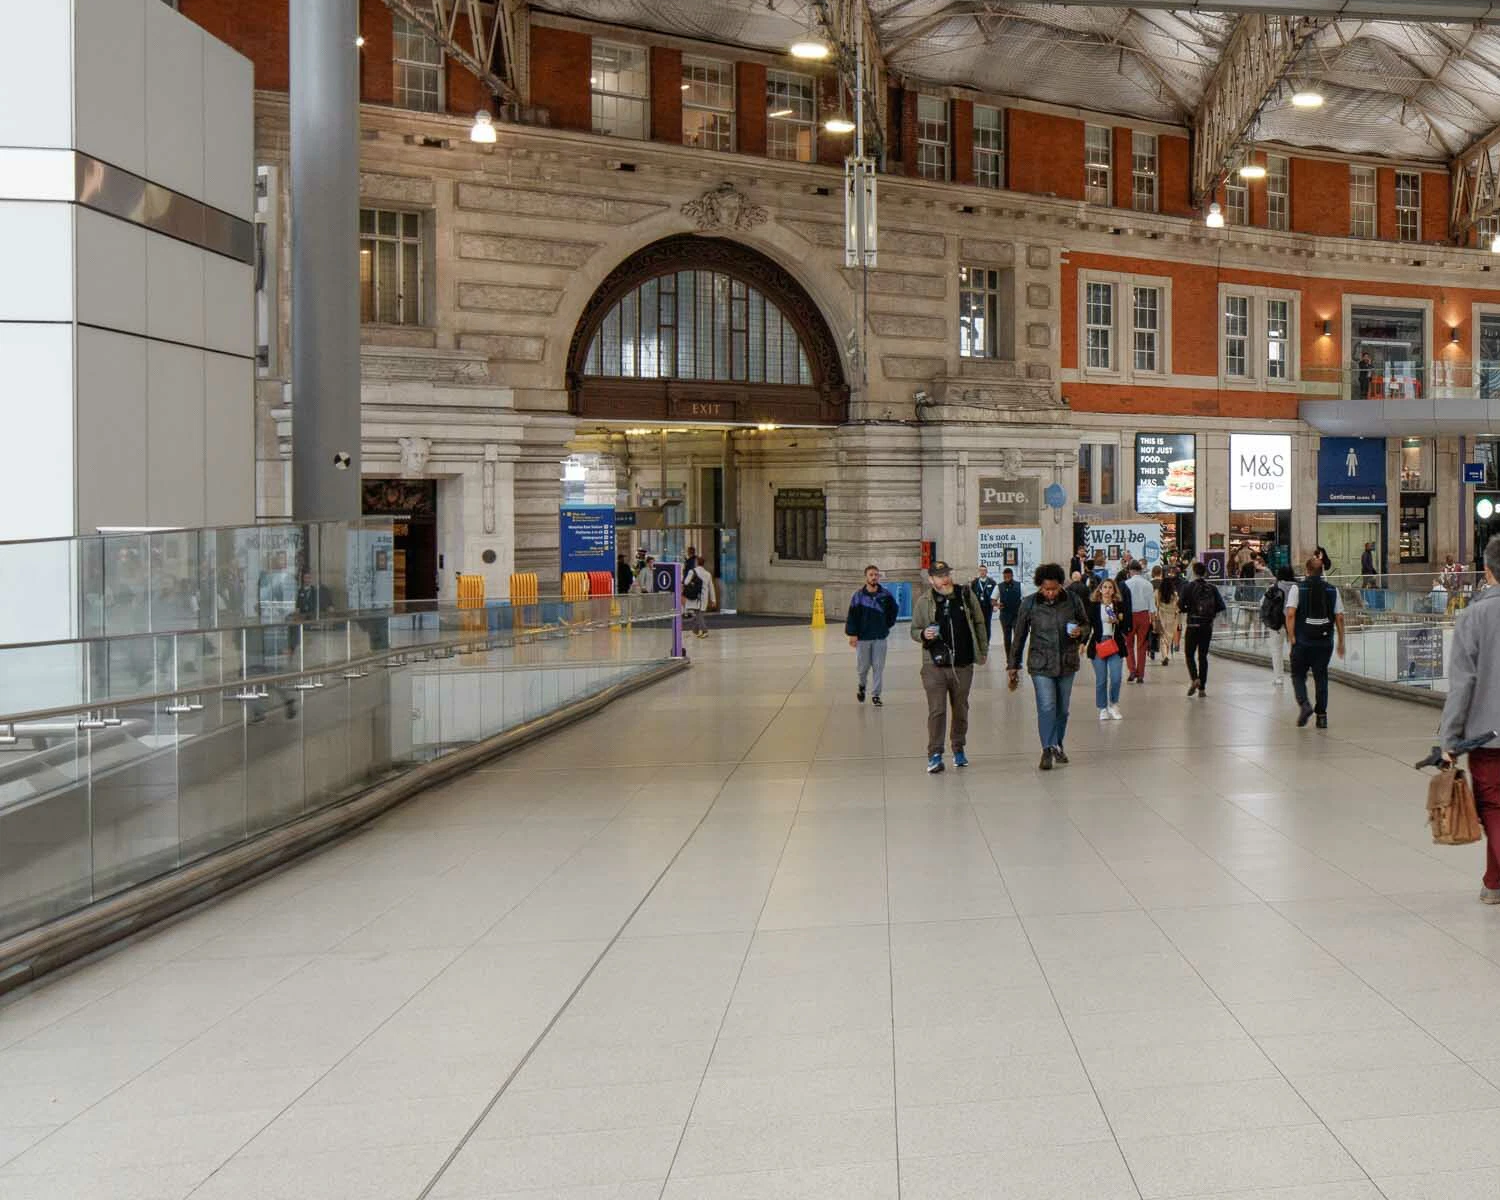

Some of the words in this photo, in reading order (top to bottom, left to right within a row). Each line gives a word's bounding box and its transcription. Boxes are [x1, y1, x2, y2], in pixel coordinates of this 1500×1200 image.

[693, 404, 720, 415] EXIT
[1240, 454, 1284, 477] M&S
[1250, 482, 1274, 490] FOOD
[983, 487, 1029, 503] Pure.
[980, 533, 993, 541] It's
[996, 533, 1009, 541] not
[1090, 529, 1125, 543] We'll
[1128, 529, 1145, 543] be
